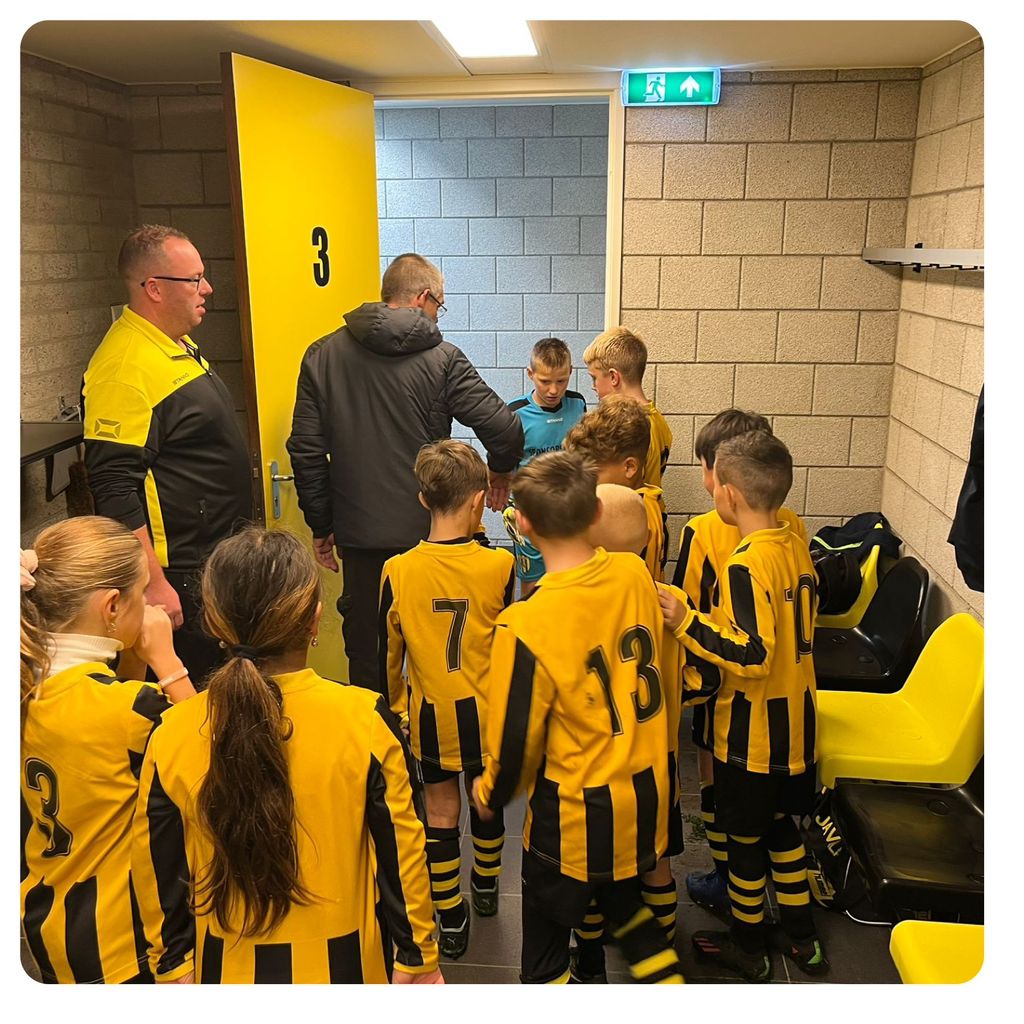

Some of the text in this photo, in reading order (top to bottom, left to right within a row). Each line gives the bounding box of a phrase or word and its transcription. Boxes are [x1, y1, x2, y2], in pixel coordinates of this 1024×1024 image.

[312, 226, 329, 287] 3
[432, 598, 469, 673] 7
[586, 624, 662, 737] 13
[24, 757, 73, 858] 3
